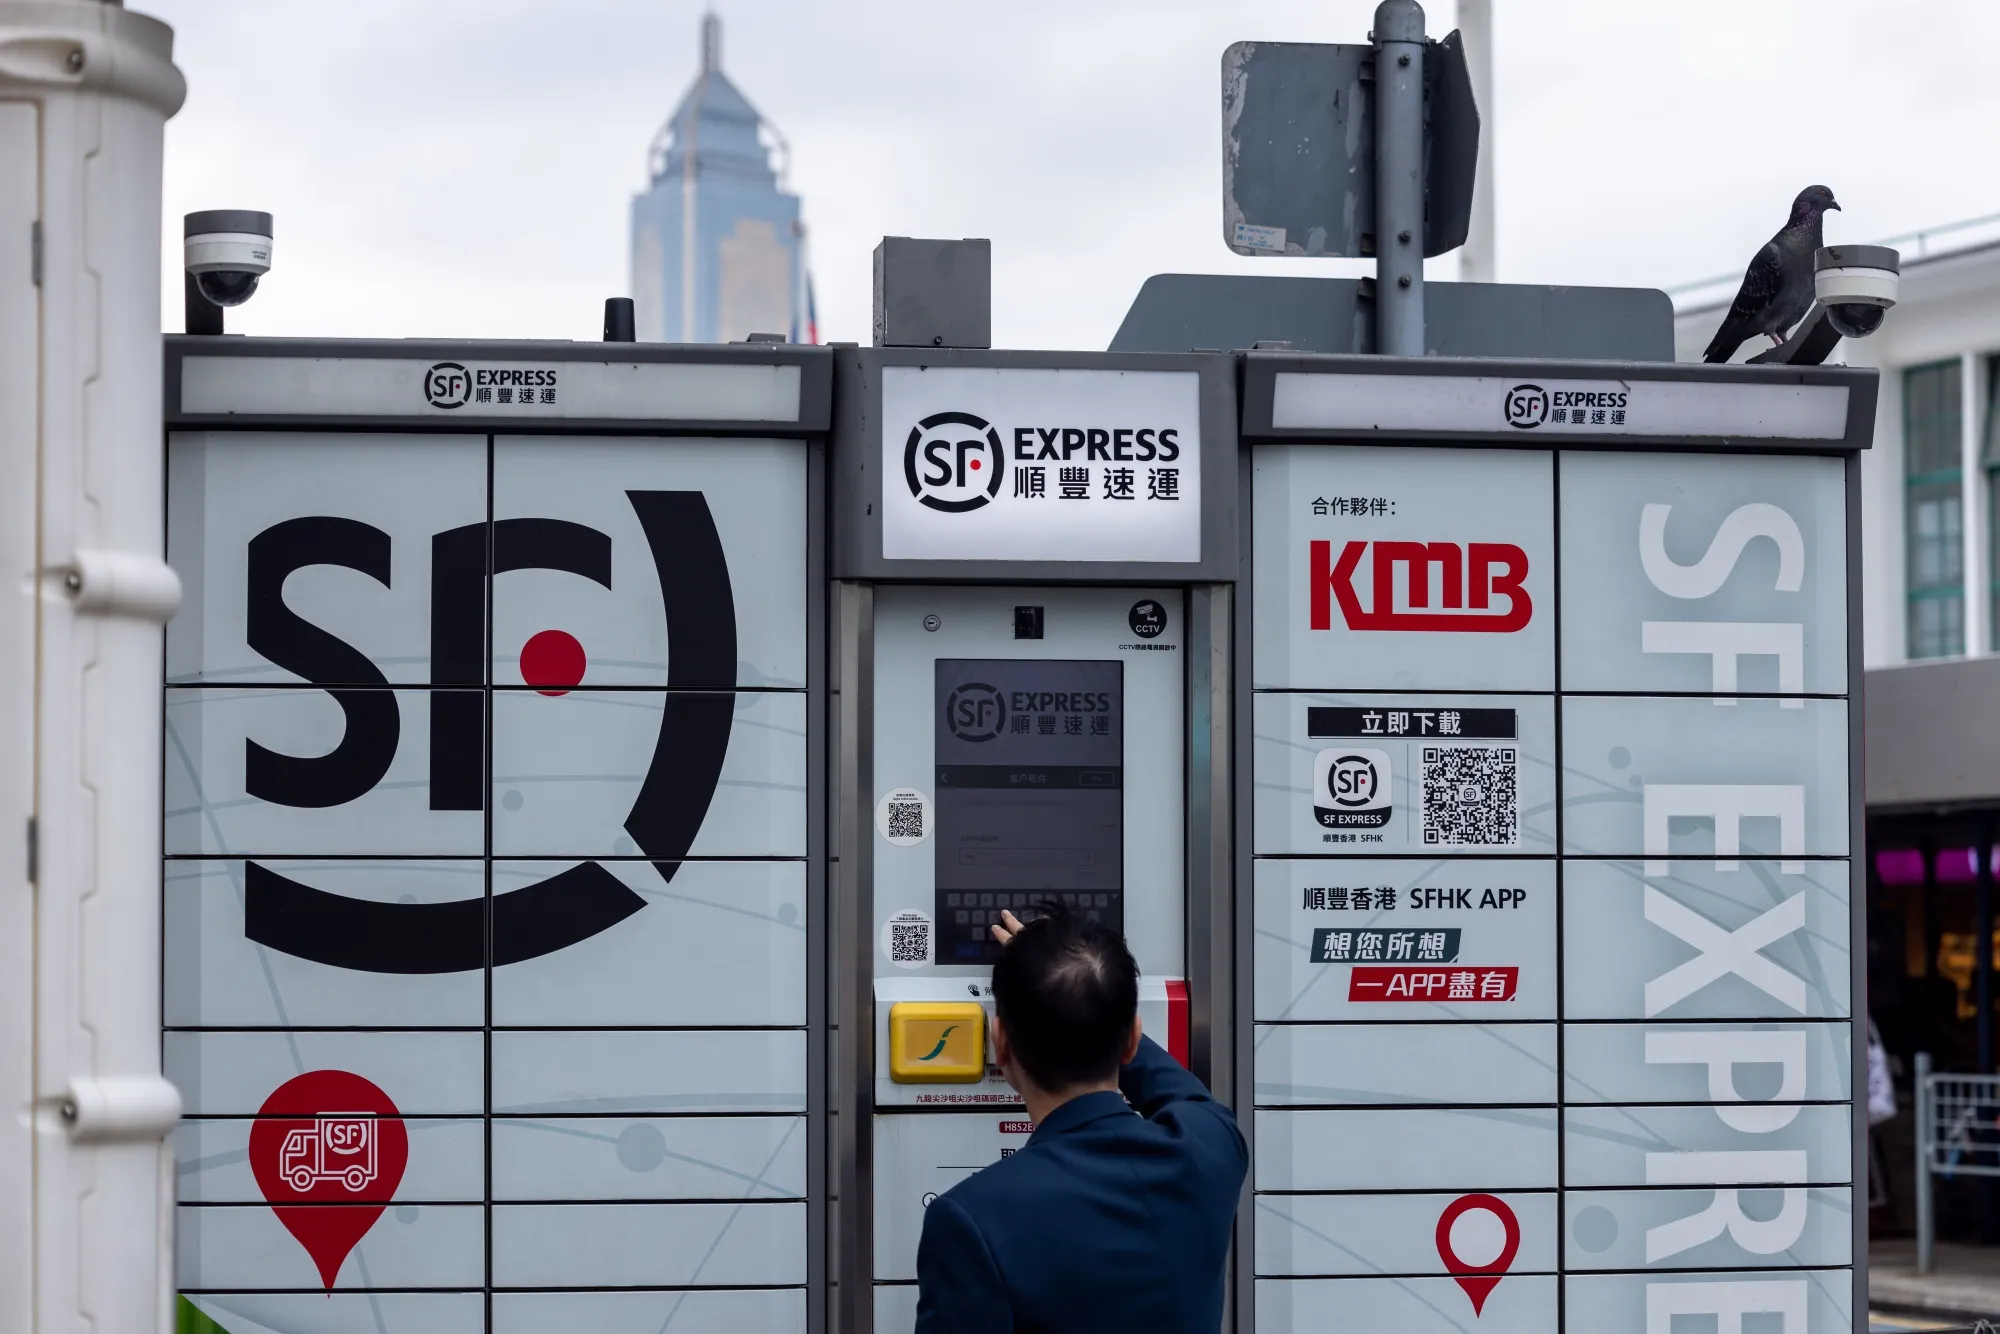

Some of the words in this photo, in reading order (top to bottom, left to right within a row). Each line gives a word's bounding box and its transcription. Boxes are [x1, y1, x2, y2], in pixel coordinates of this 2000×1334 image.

[477, 370, 556, 387] EXPRESS
[476, 387, 555, 404] 順豐速運
[1553, 392, 1627, 408] EXPRESS
[1551, 409, 1626, 425] 順豐速運
[924, 440, 985, 488] SF
[1014, 428, 1180, 462] EXPRESS
[1013, 466, 1180, 501] 順豐速運
[1639, 503, 1805, 709] SF
[246, 516, 611, 810] SF
[1011, 692, 1110, 713] EXPRESS
[1011, 715, 1109, 735] 順豐速運
[1361, 710, 1461, 735] 立即下載
[1337, 769, 1368, 793] SF
[1324, 815, 1336, 824] SF
[1338, 815, 1382, 825] EXPRESS
[1323, 833, 1356, 843] 順豐香港
[1361, 834, 1383, 842] SFHK
[1303, 887, 1397, 911] 順豐香港
[1410, 888, 1472, 909] SFHK
[1479, 889, 1526, 909] APP
[1324, 932, 1446, 960] 想您所想
[1356, 971, 1508, 998] 一APP盡有
[915, 1094, 1024, 1103] 九龍尖沙咀尖沙咀碼頭巴士總
[1004, 1122, 1034, 1132] H852E
